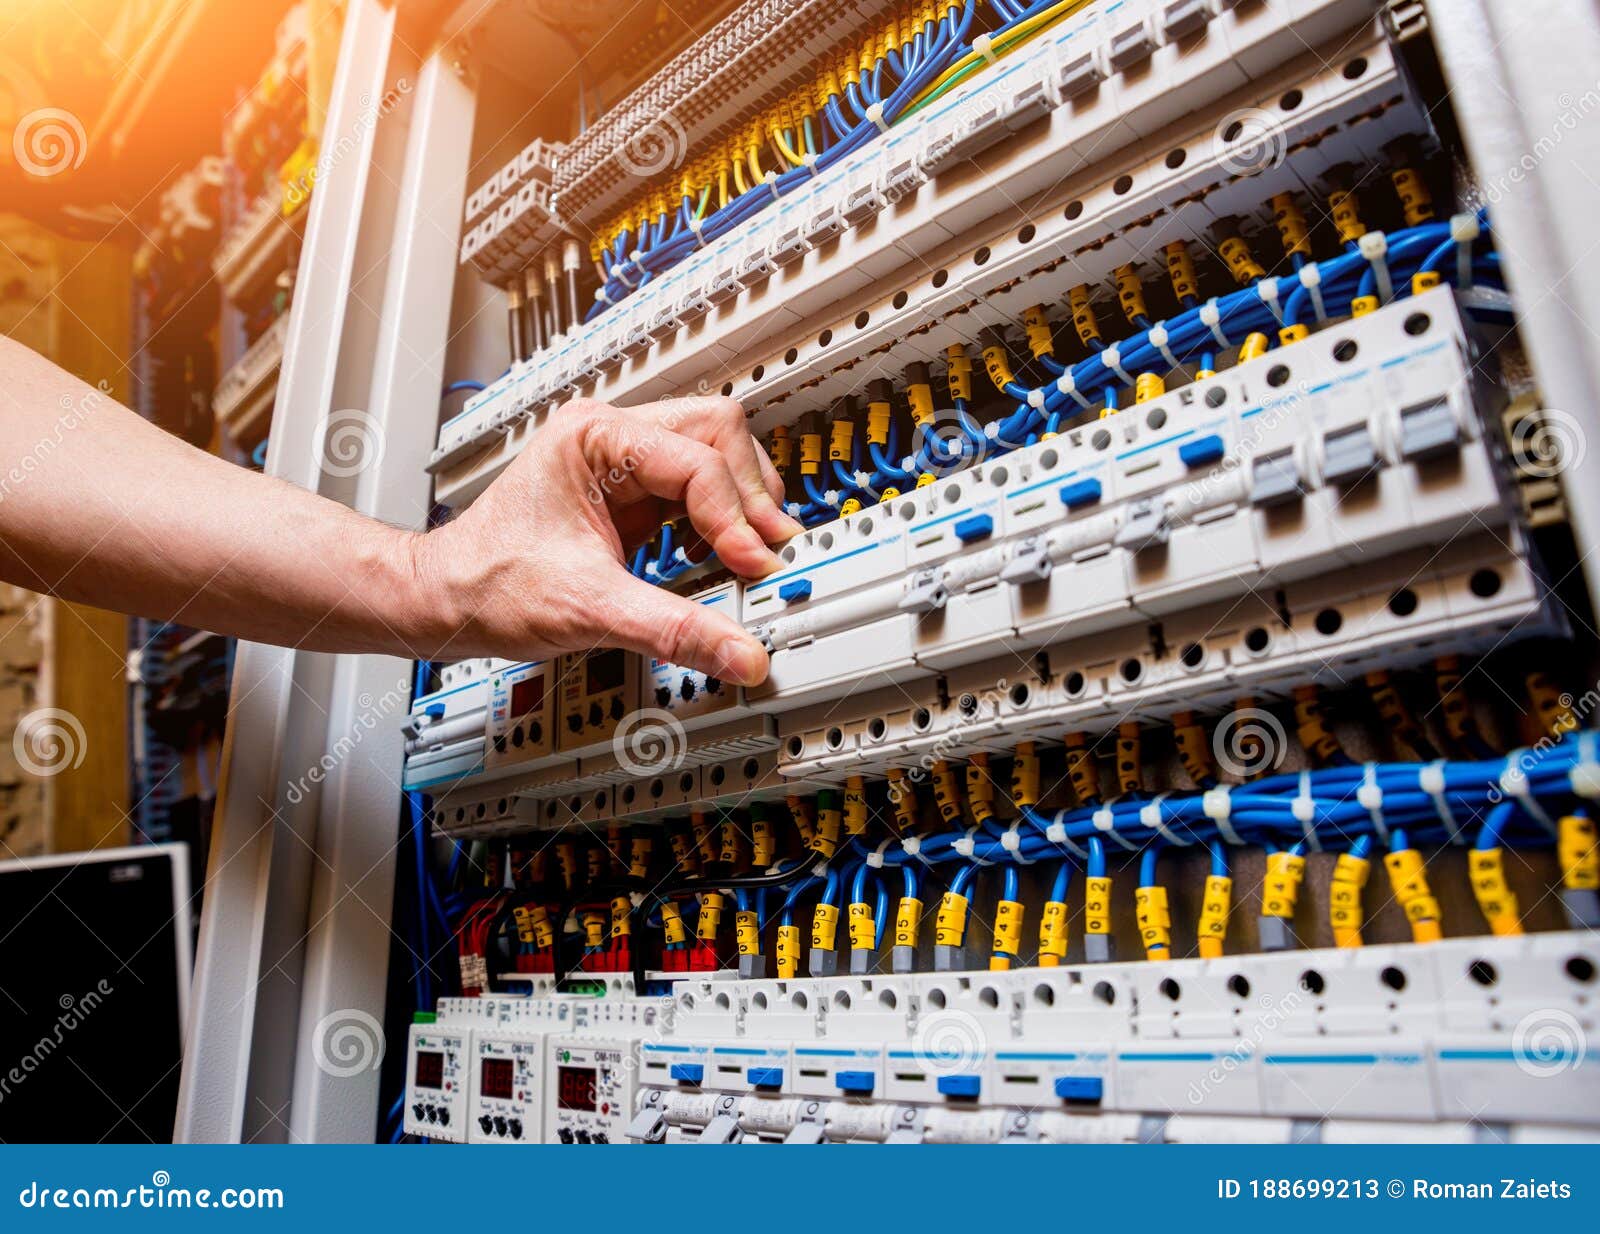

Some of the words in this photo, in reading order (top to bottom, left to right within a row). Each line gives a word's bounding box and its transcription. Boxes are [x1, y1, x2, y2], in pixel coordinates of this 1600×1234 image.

[898, 902, 910, 942] 051
[936, 897, 951, 941] 042
[1089, 882, 1106, 930] 052
[1207, 881, 1229, 932] 052
[736, 915, 748, 952] 053
[812, 909, 826, 945] 053
[849, 907, 864, 946] 042
[1040, 906, 1059, 947] 045
[777, 930, 789, 966] 042
